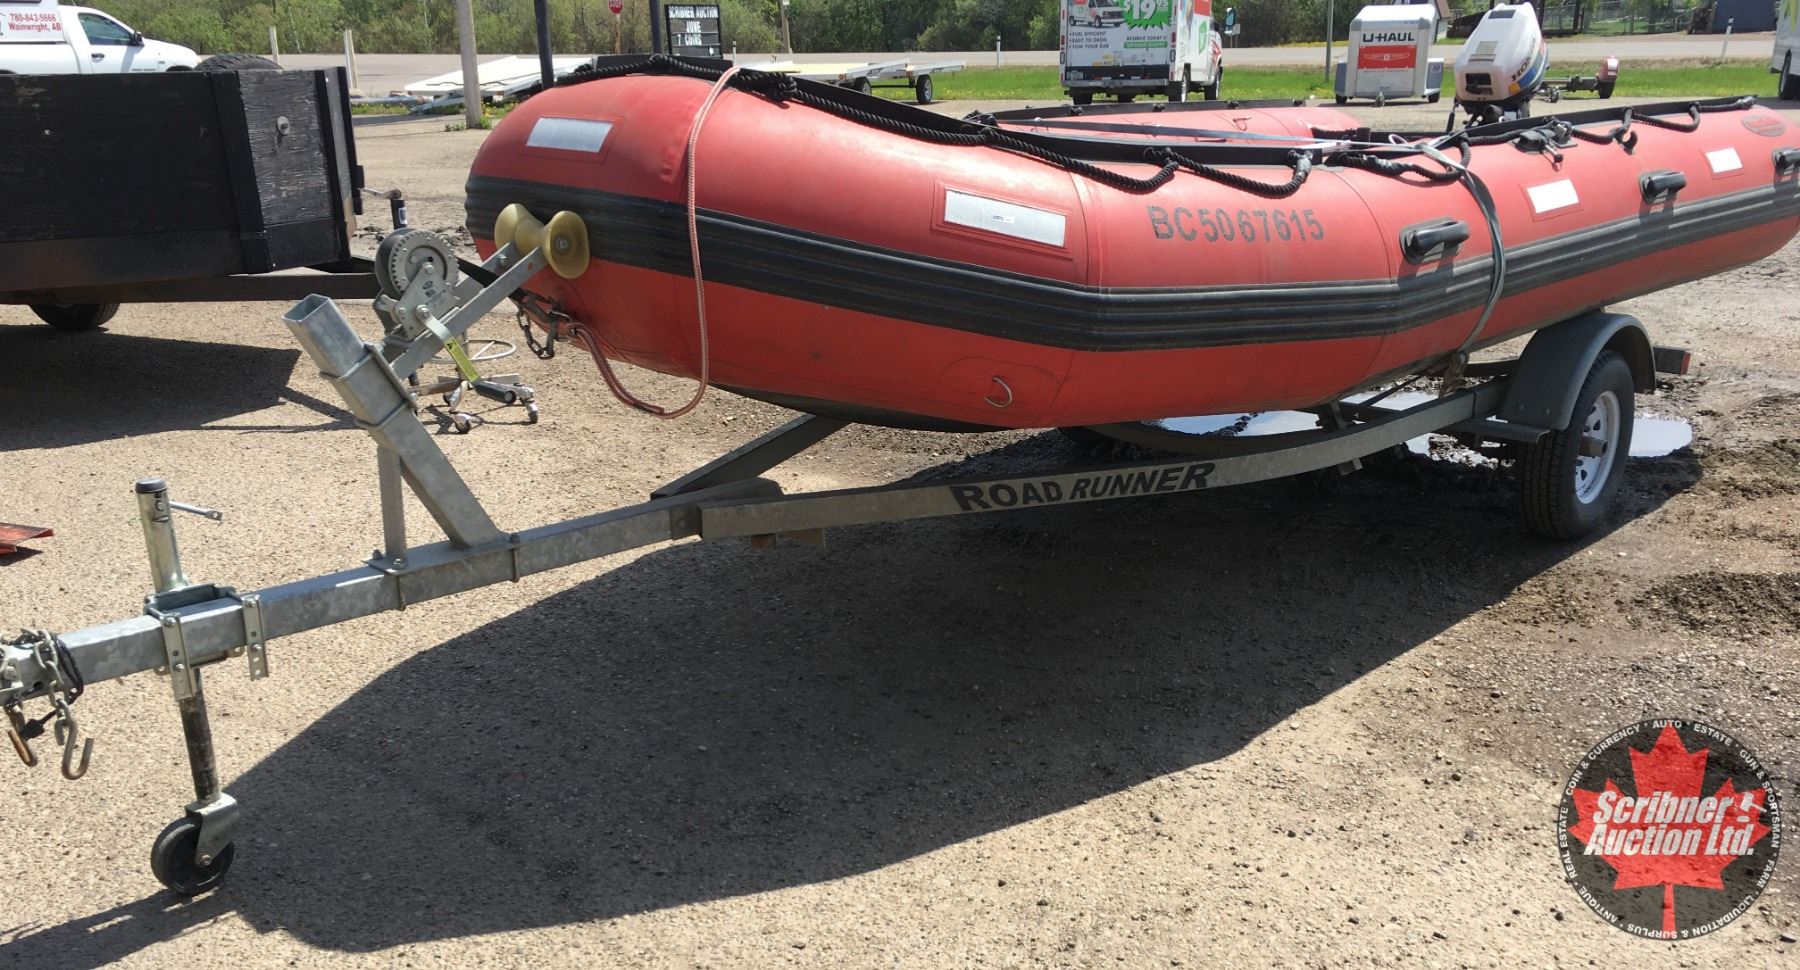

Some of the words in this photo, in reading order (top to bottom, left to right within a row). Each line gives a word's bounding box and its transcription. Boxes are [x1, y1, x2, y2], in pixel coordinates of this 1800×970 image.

[668, 6, 694, 18] SCRIBNER
[695, 6, 719, 18] AUCTION
[8, 22, 50, 32] Wainwright,
[52, 22, 61, 31] AB
[686, 21, 701, 33] JUNE
[1362, 32, 1415, 42] U-HAUL
[1146, 205, 1324, 243] BC5067615
[950, 481, 1063, 511] ROAD
[1070, 462, 1215, 499] RUNNER
